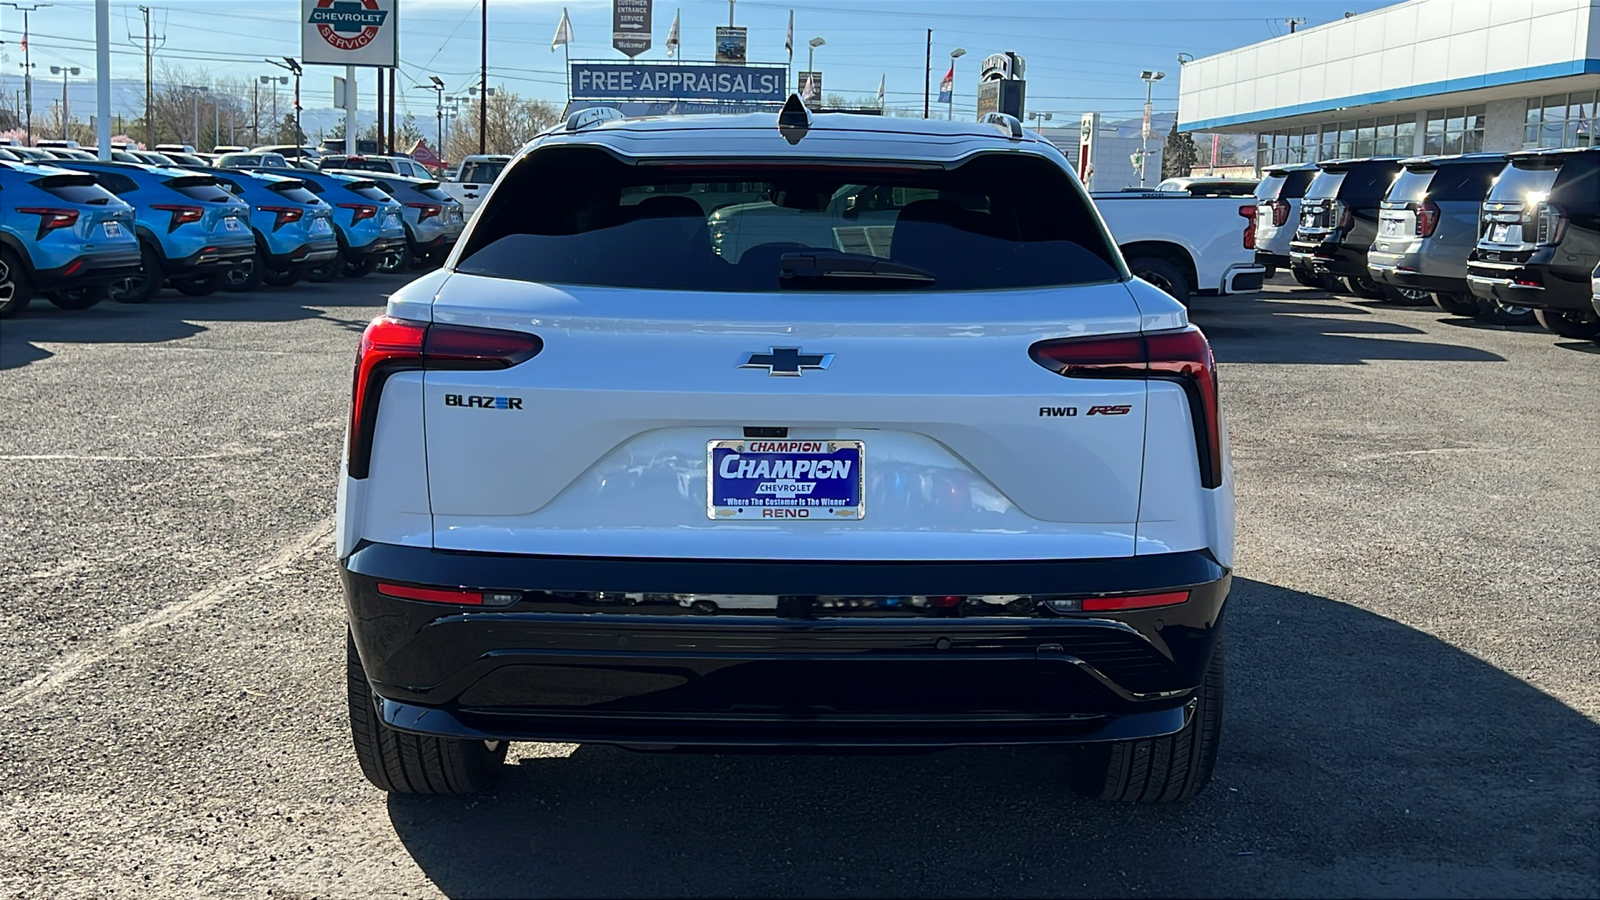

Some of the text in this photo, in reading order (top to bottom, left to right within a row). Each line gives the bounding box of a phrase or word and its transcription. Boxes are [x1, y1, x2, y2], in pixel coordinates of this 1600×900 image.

[313, 12, 382, 22] CHEVROLET
[321, 27, 375, 48] SERVICE
[578, 70, 634, 92] FREE
[639, 71, 780, 95] APPRAISALS!
[684, 104, 719, 113] Kelley
[445, 393, 523, 410] BLAZER
[1039, 404, 1133, 417] AWD RS
[749, 442, 822, 453] CHAMPION
[719, 454, 852, 480] CHAMPION
[759, 484, 812, 492] CHEVROLET
[751, 498, 764, 506] The
[765, 498, 797, 506] Customer
[799, 498, 806, 506] Is
[807, 498, 820, 506] The
[762, 508, 810, 518] RENO
